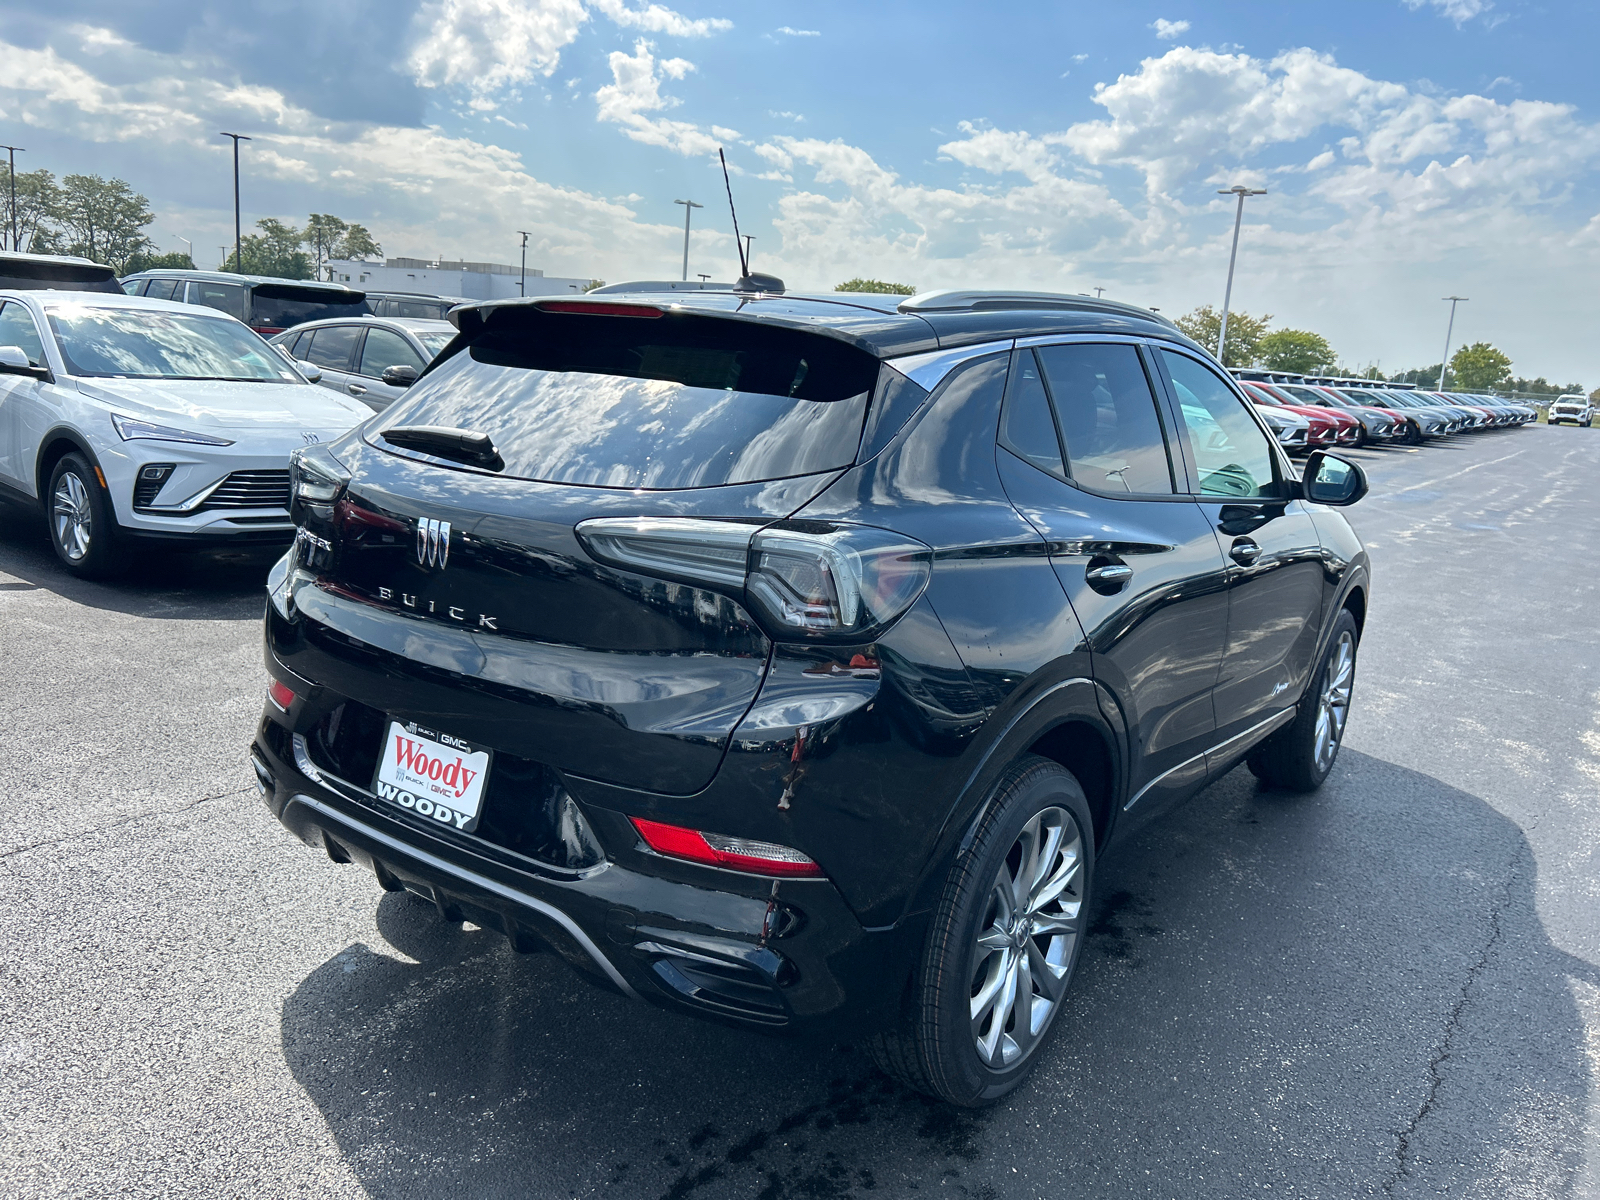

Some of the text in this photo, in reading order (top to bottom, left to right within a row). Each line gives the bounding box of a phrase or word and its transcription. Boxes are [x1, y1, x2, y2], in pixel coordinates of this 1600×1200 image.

[378, 586, 498, 630] BUICK
[417, 727, 467, 750] BUICK GMC
[395, 735, 477, 798] Woody
[405, 775, 452, 799] BUICK GMC
[377, 781, 472, 829] WOODY
